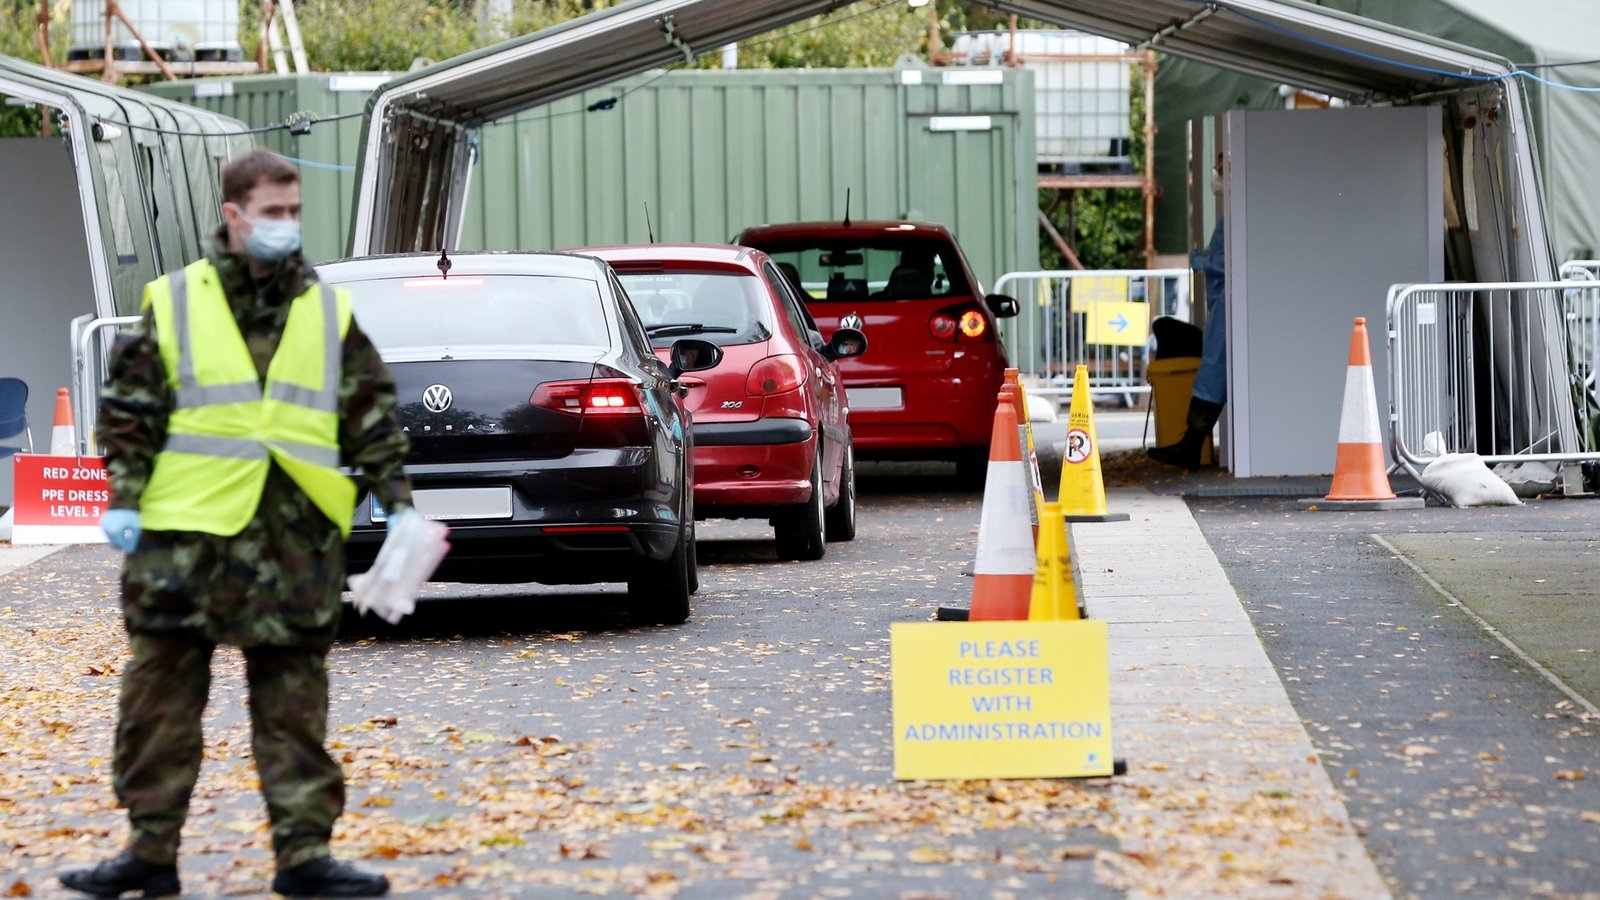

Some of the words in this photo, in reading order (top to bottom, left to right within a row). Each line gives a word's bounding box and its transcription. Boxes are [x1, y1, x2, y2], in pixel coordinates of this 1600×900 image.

[720, 400, 743, 409] 206
[402, 423, 496, 433] ASSAT
[43, 467, 69, 479] RED
[72, 468, 107, 480] ZONE
[42, 489, 65, 501] PPE
[68, 490, 109, 502] DRESS
[50, 505, 88, 517] LEVEL
[92, 506, 100, 518] 3
[960, 640, 1040, 658] PLEASE
[949, 668, 1054, 686] REGISTER
[972, 695, 1031, 712] WITH
[904, 722, 1102, 741] ADMINISTRATION
